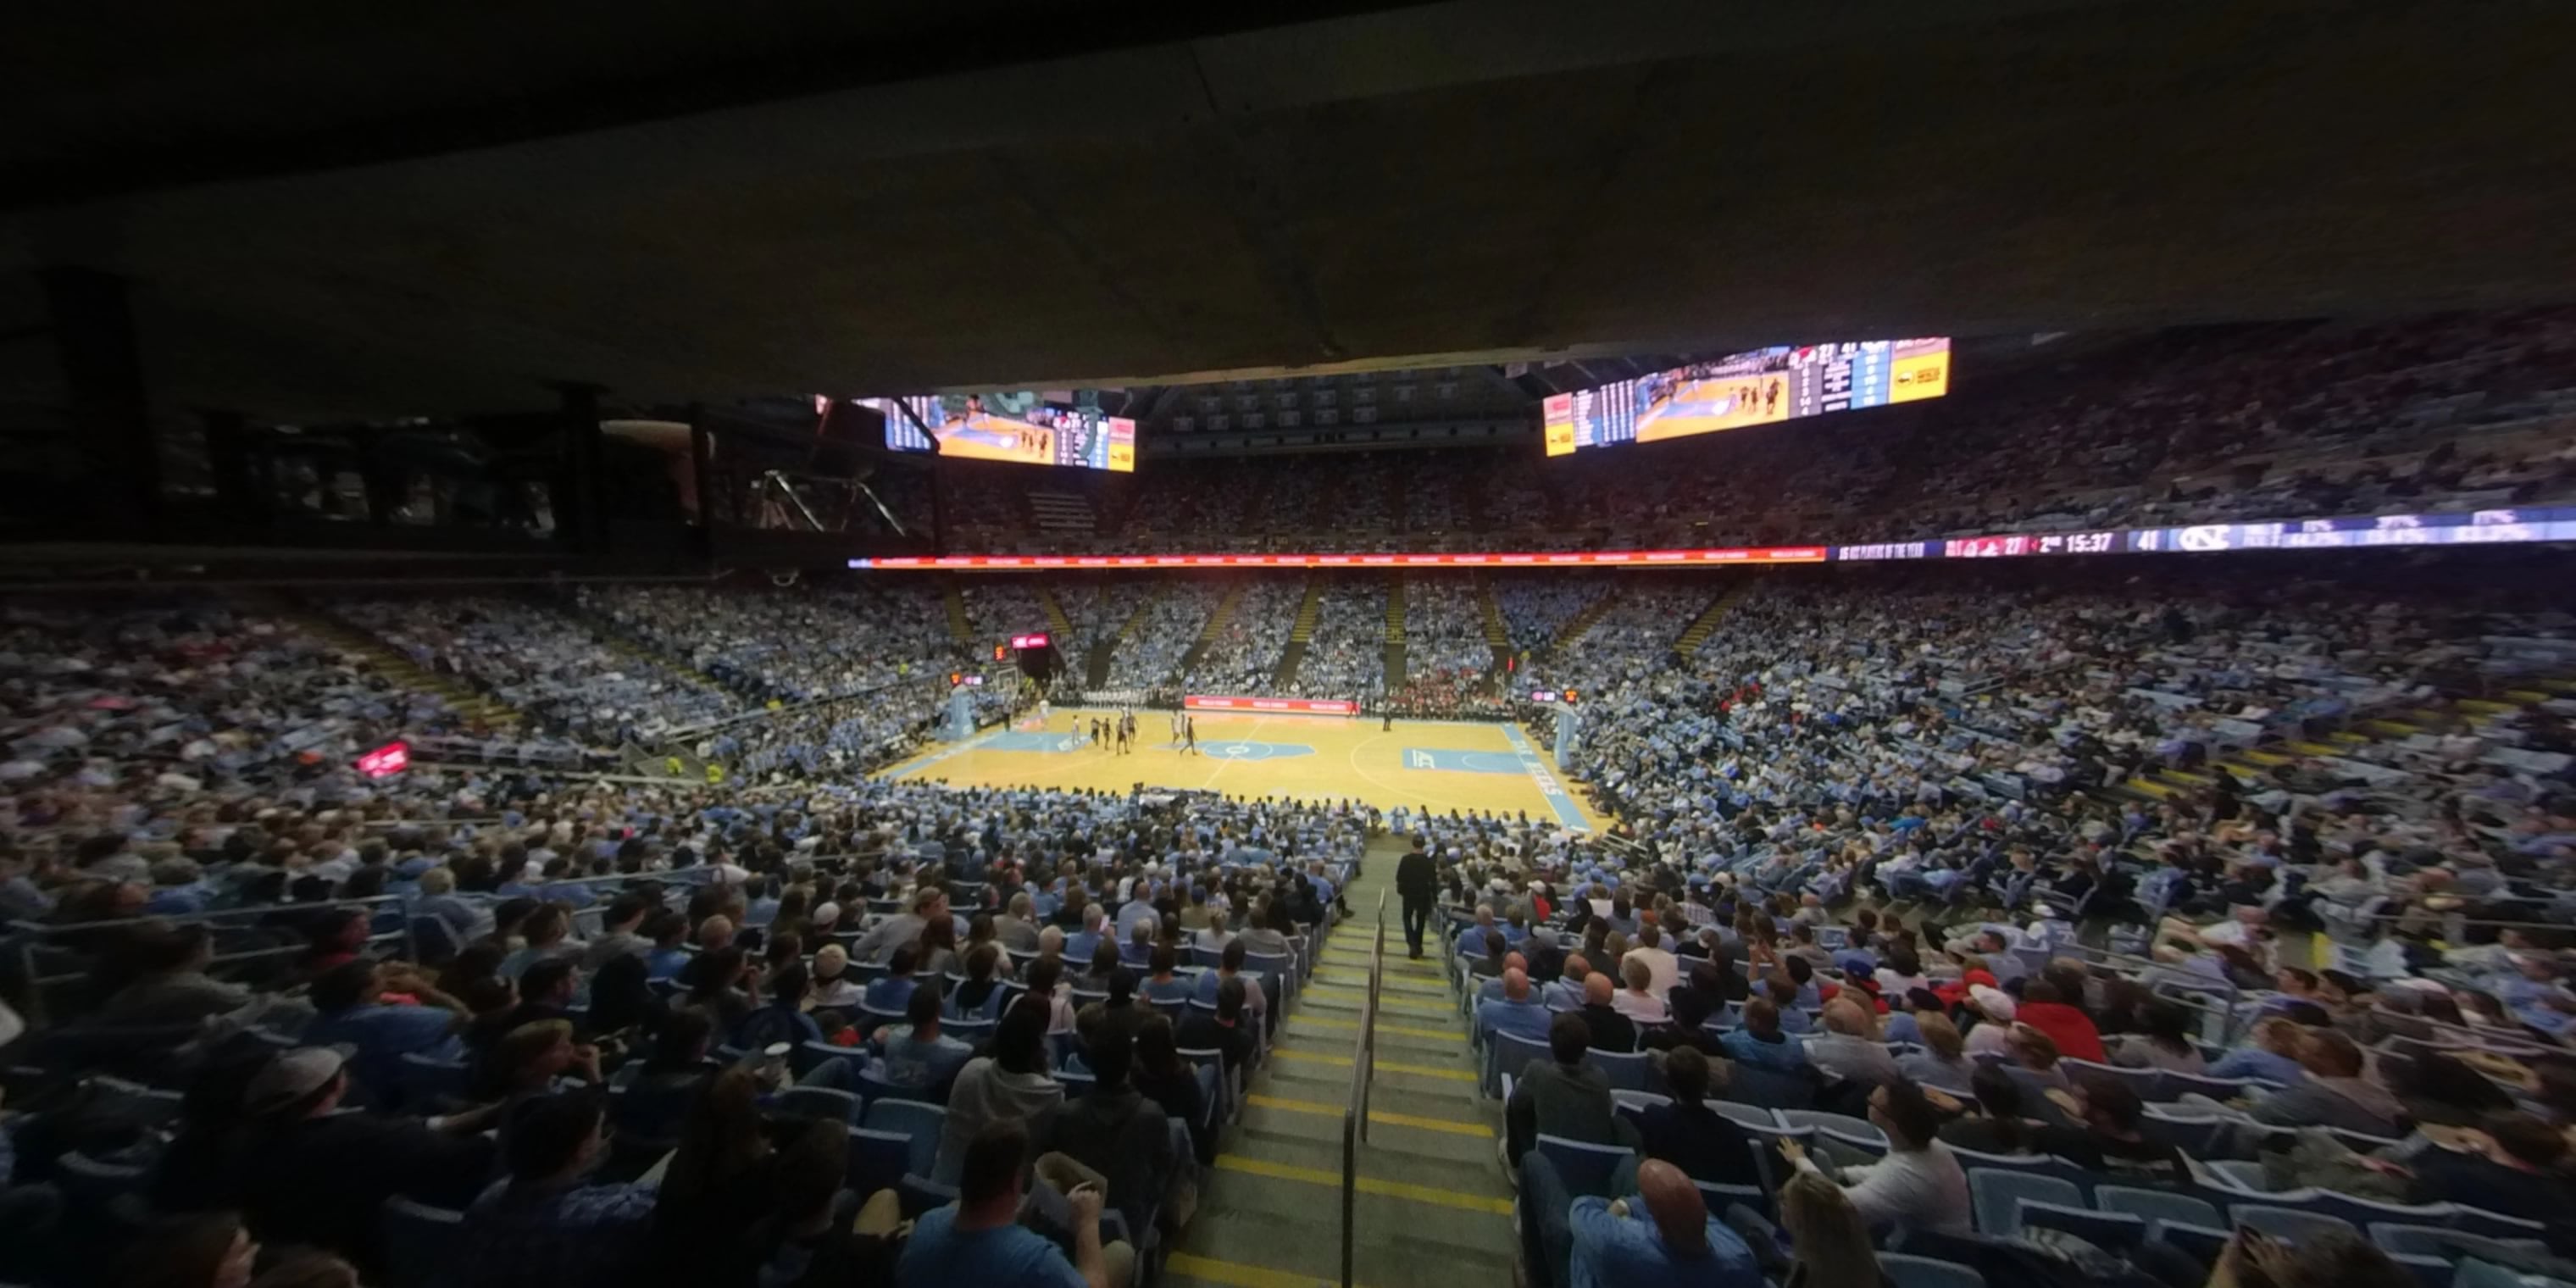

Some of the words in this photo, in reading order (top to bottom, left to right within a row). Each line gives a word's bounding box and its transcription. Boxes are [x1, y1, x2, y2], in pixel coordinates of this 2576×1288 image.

[2005, 536, 2024, 555] 27
[2067, 532, 2113, 553] 15:37
[2137, 530, 2159, 551] 41
